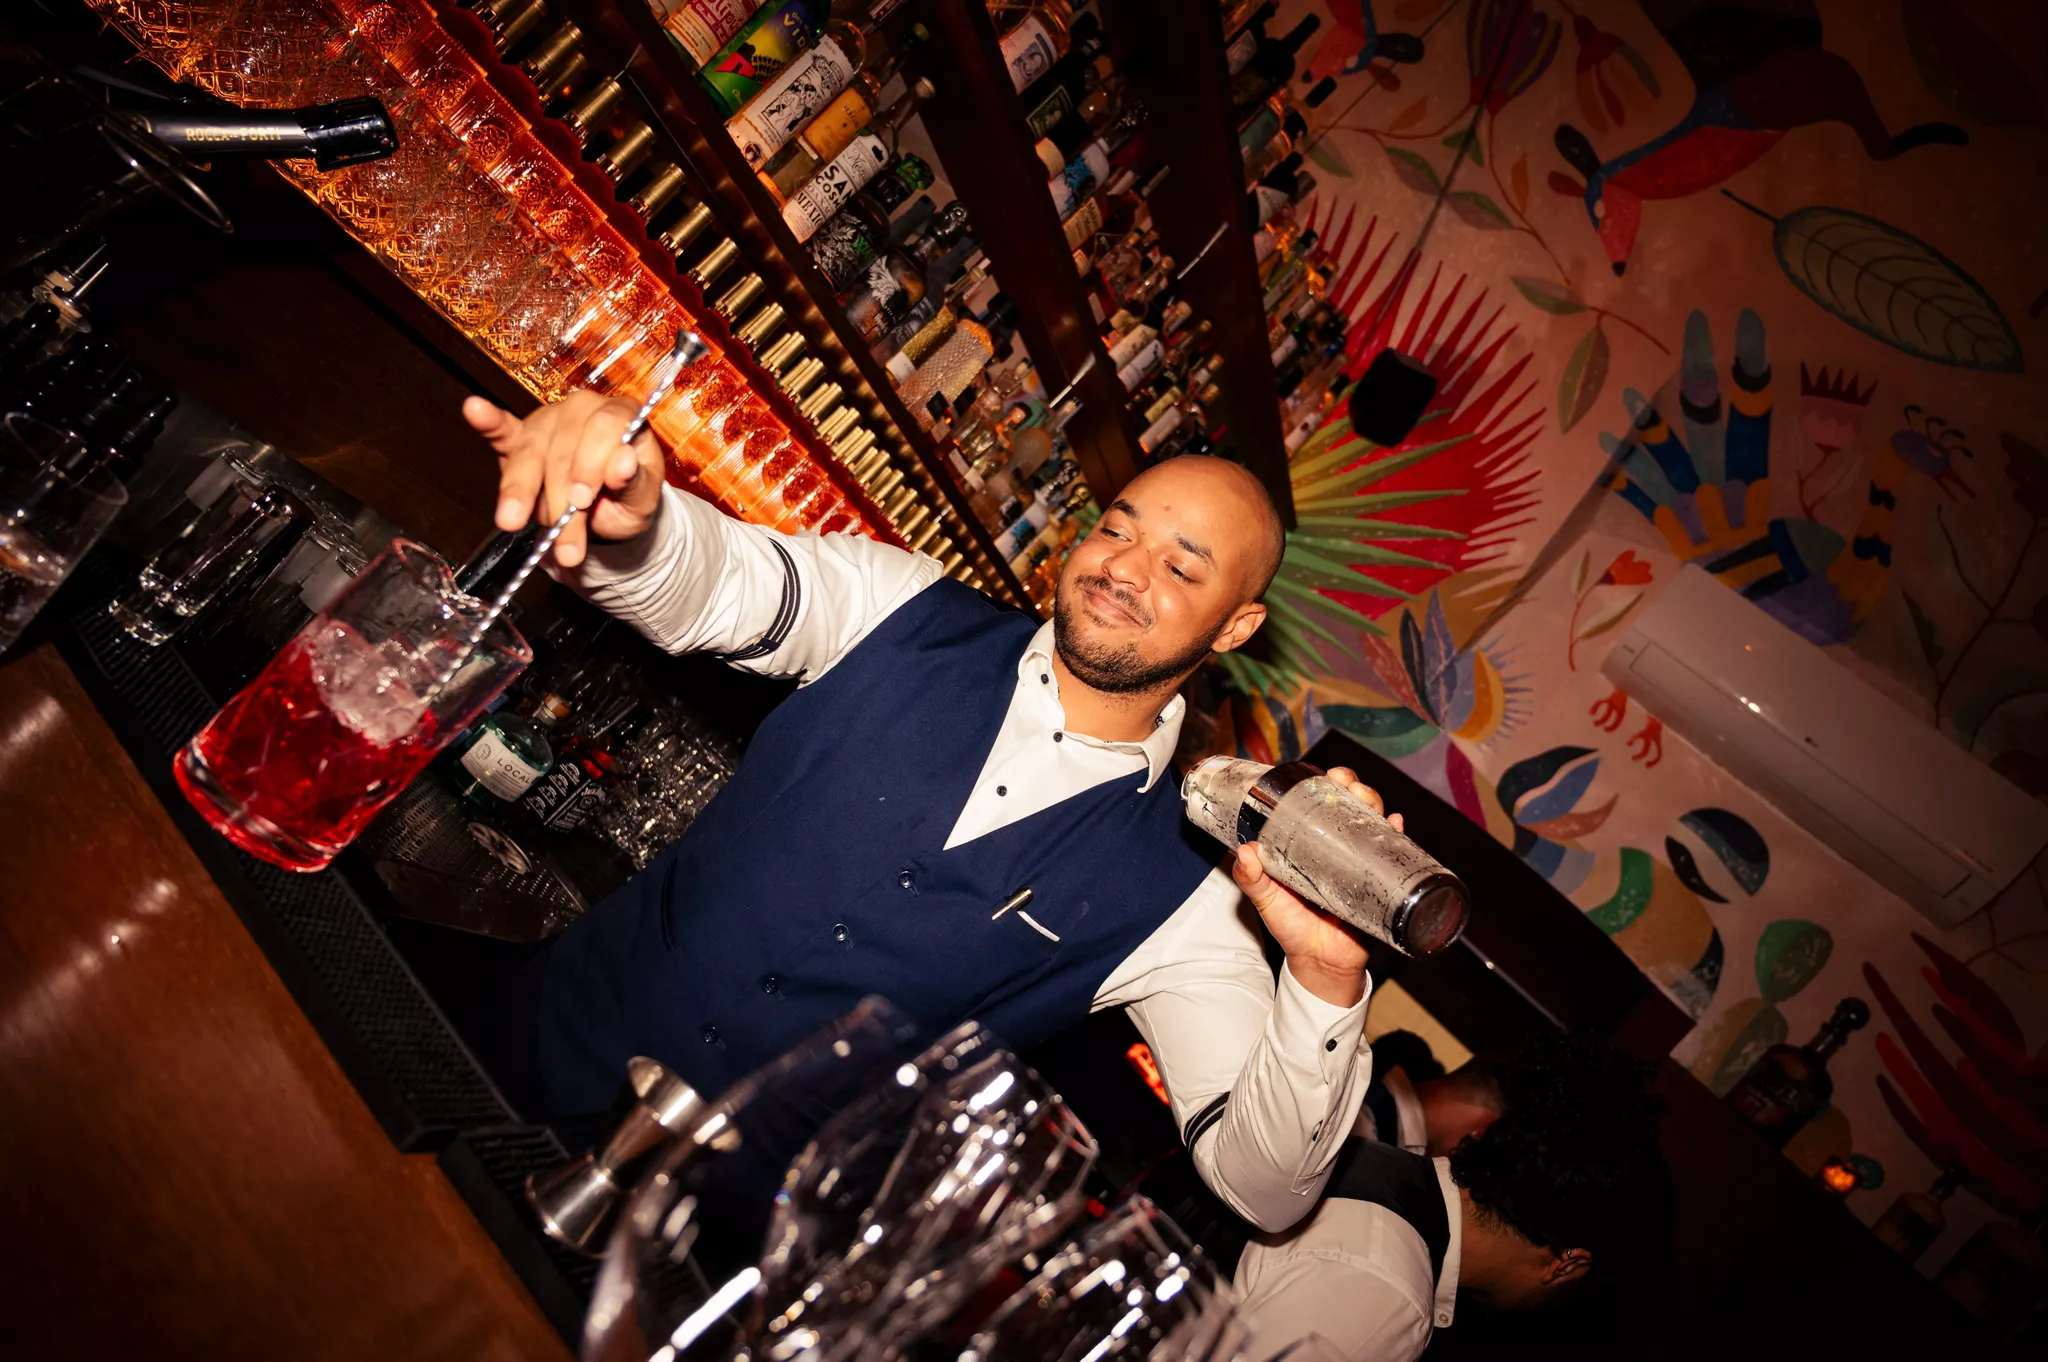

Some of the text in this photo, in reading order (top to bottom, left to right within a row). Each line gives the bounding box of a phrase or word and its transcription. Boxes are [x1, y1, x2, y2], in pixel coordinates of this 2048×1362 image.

[783, 12, 806, 48] VID
[184, 128, 230, 142] ROCCA
[806, 184, 832, 215] OAXAC
[815, 175, 841, 209] COSM
[795, 191, 823, 226] MEXIC
[497, 757, 535, 784] LOCAL
